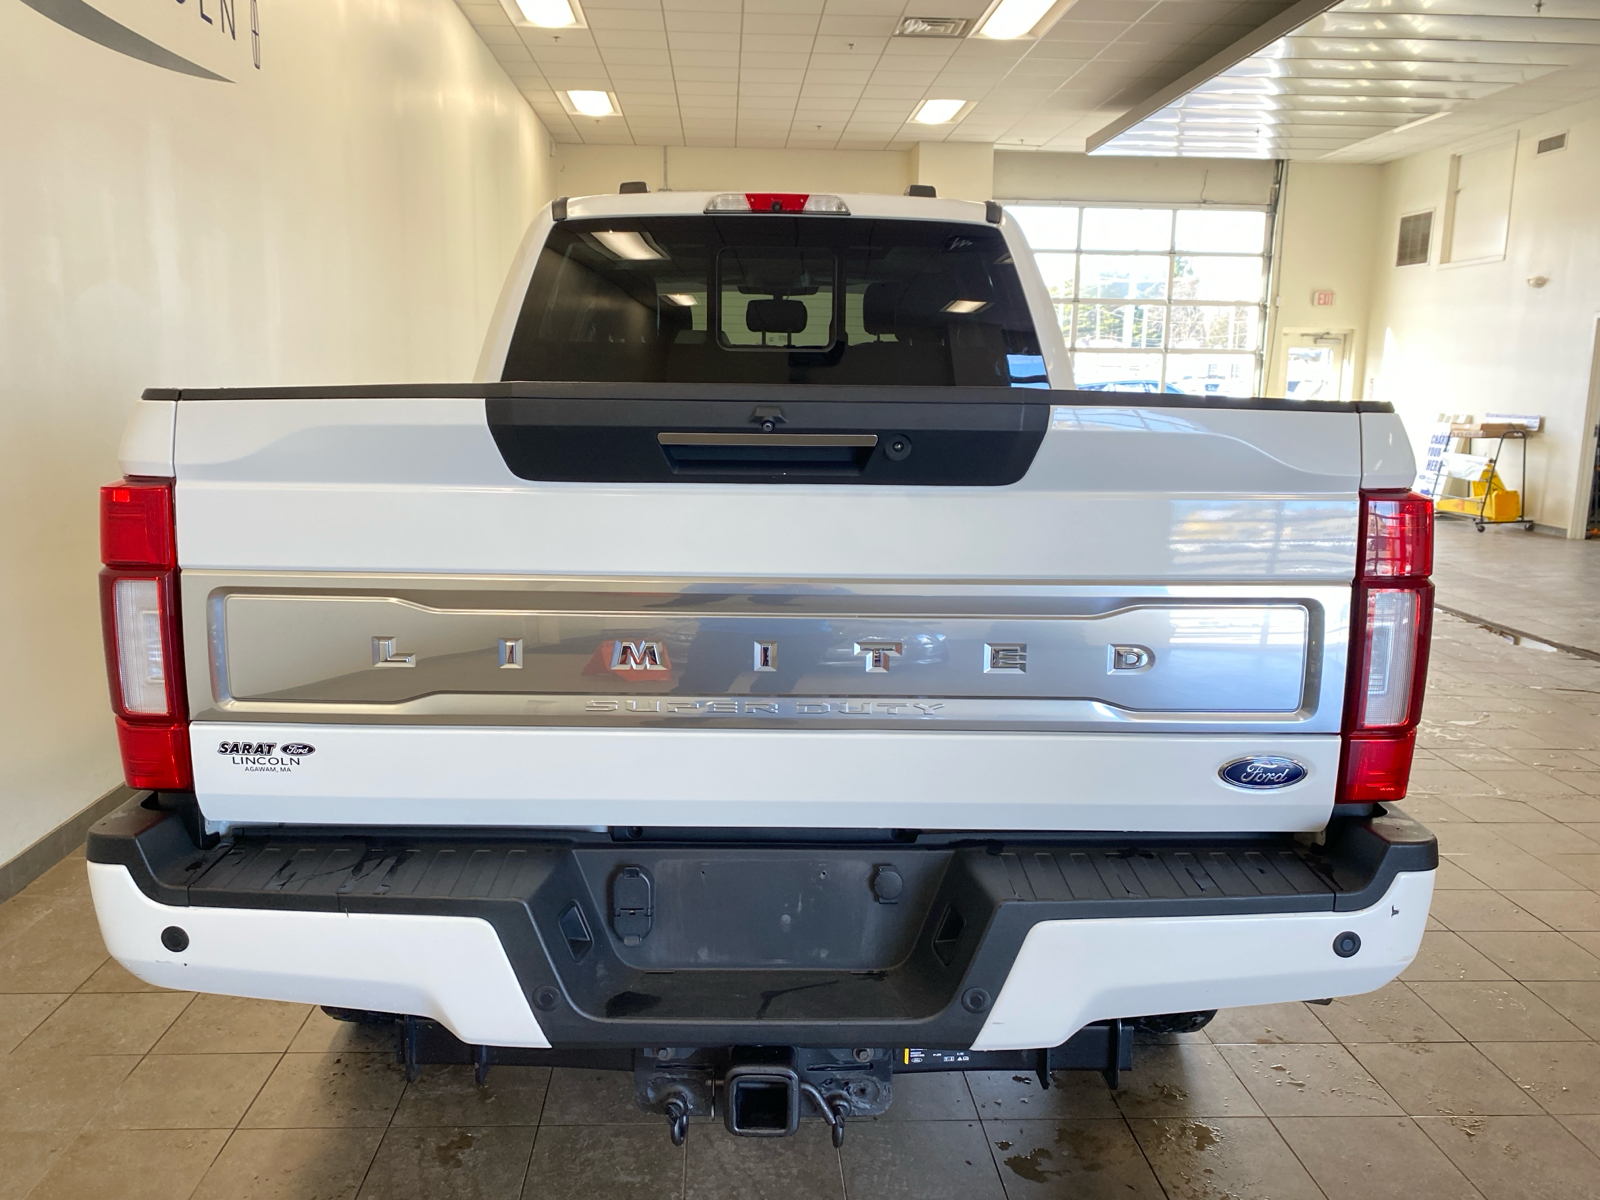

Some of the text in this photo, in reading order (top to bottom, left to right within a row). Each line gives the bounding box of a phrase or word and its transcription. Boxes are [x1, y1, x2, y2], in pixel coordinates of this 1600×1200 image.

[176, 0, 236, 41] LN
[1317, 292, 1334, 306] EXIT
[371, 635, 1157, 675] LIMITED
[585, 699, 945, 716] SUPER DUTY
[218, 741, 277, 756] SARAT
[232, 756, 301, 766] LINCOLN
